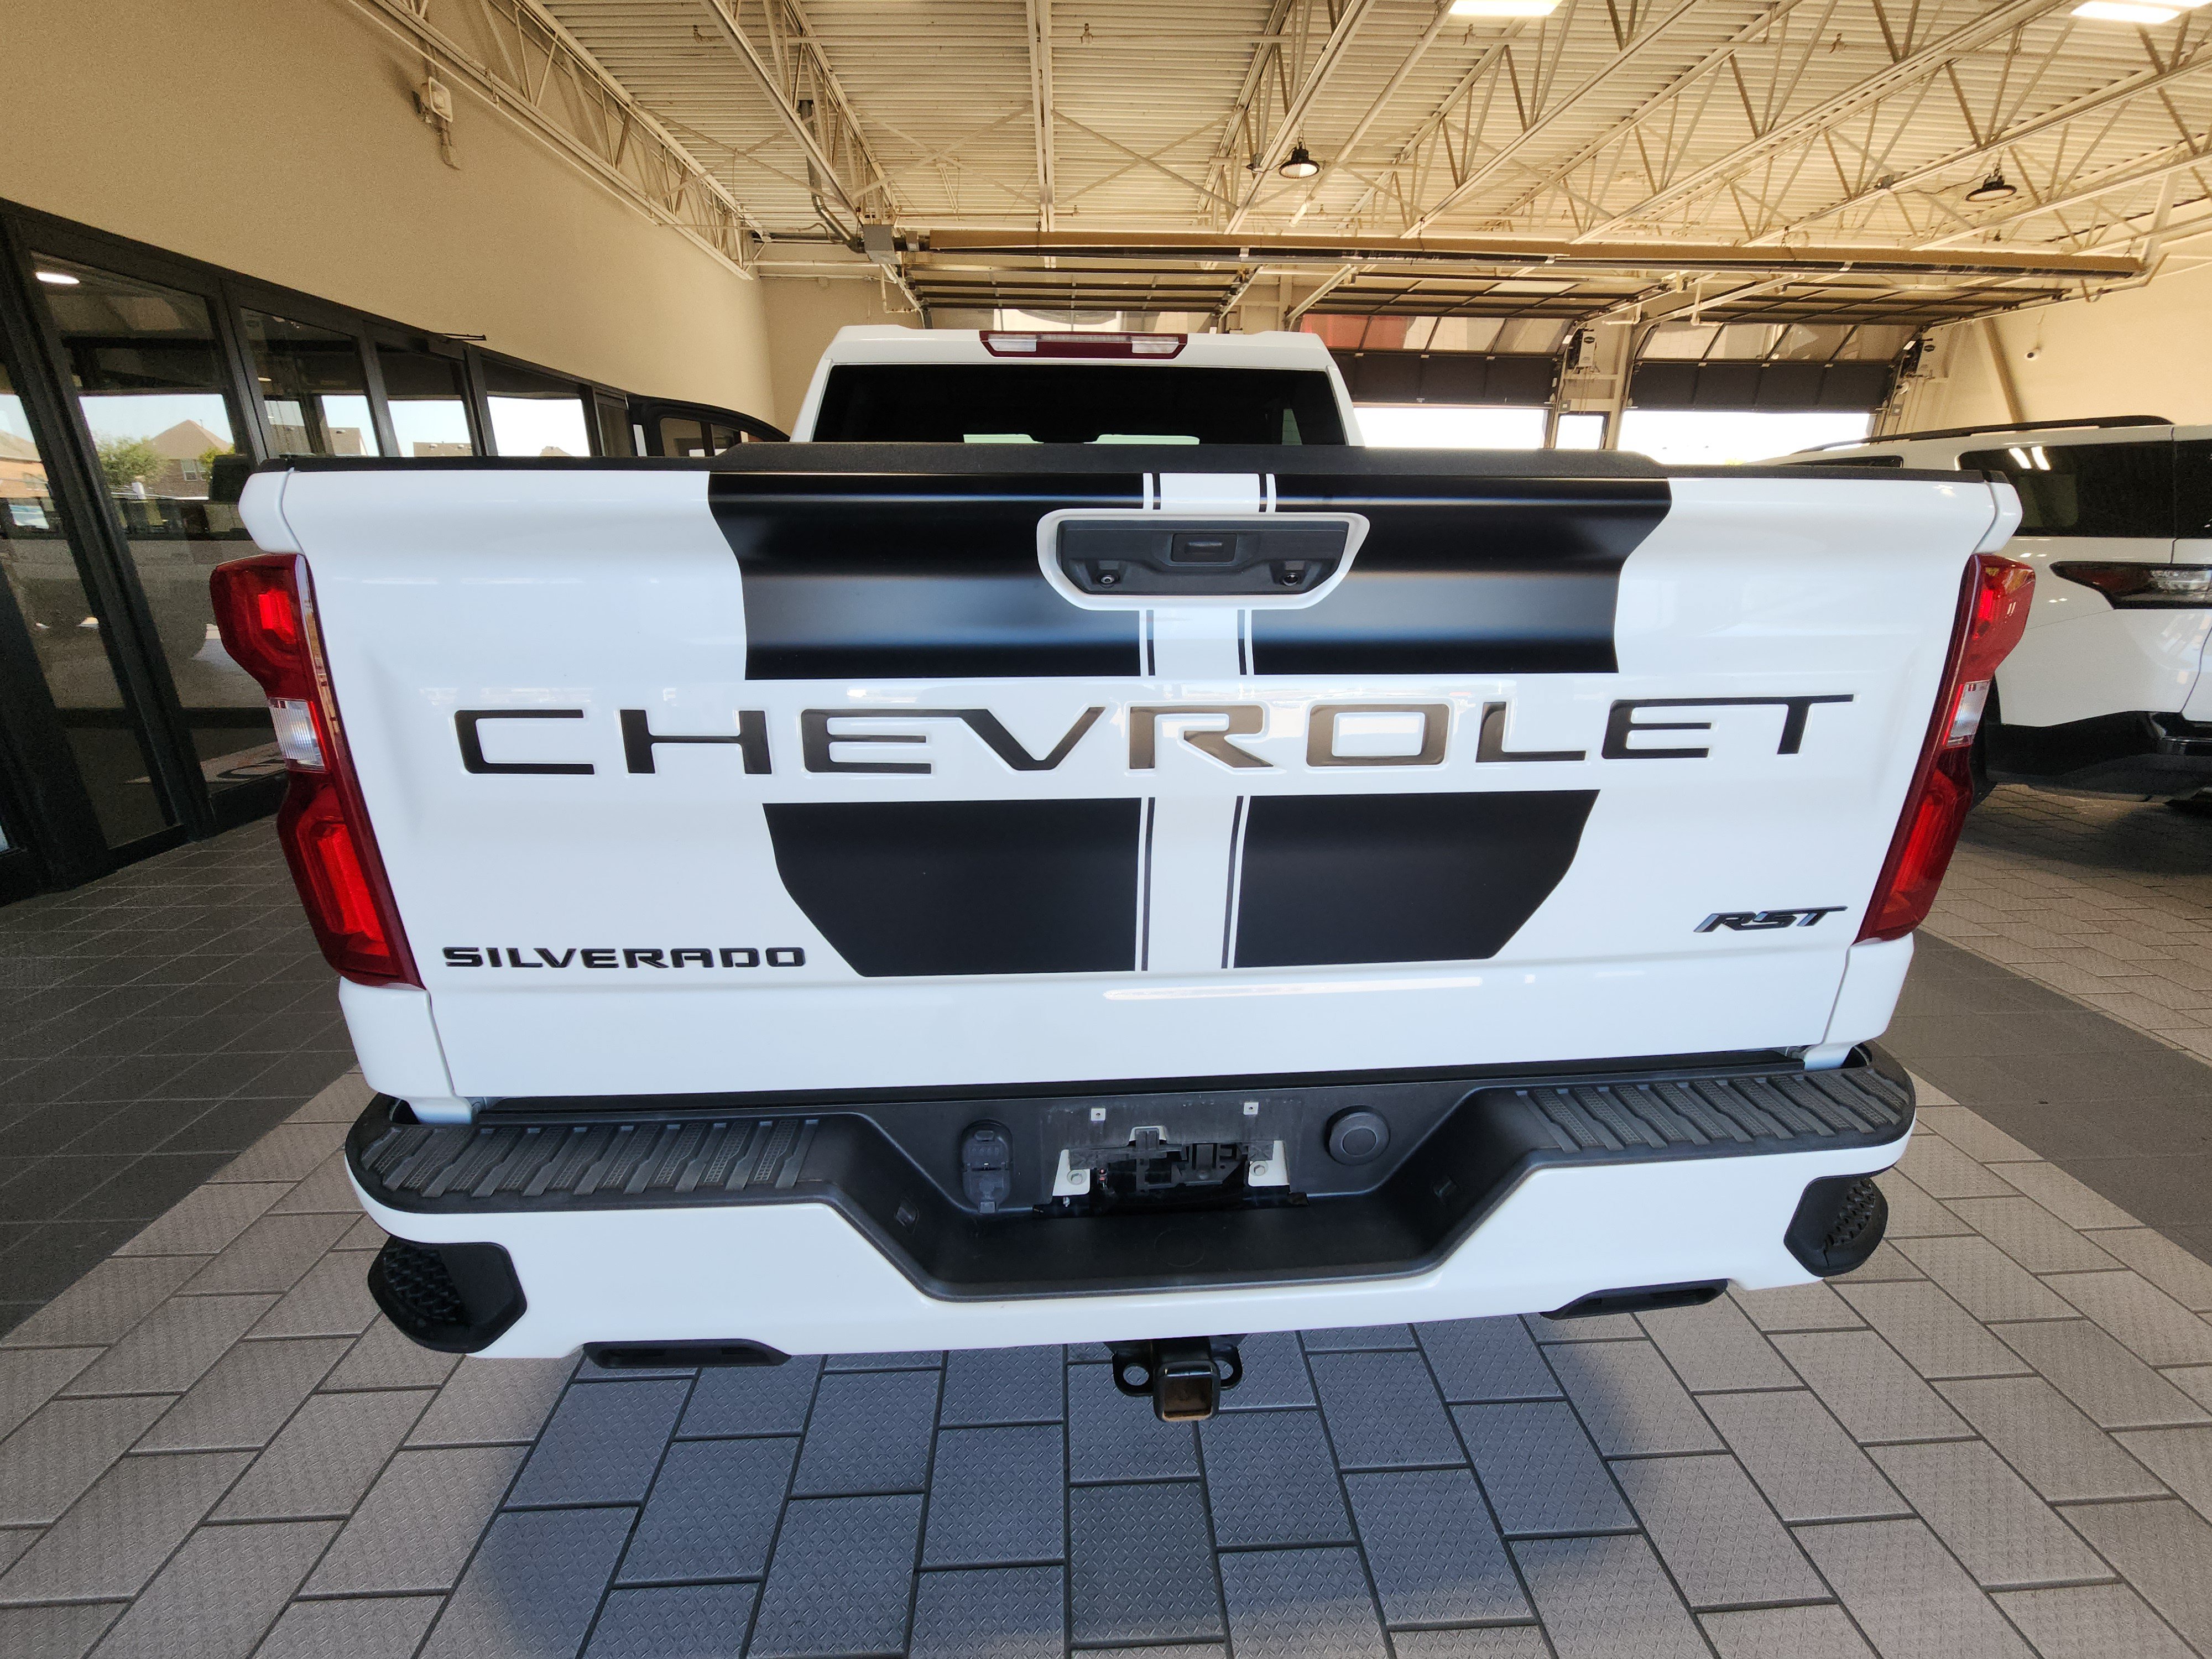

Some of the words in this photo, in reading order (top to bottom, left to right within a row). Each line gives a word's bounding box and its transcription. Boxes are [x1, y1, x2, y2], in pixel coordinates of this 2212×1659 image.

[454, 693, 1854, 775] CHEVROLET
[1693, 905, 1849, 933] RST
[442, 947, 806, 969] SILVERADO
